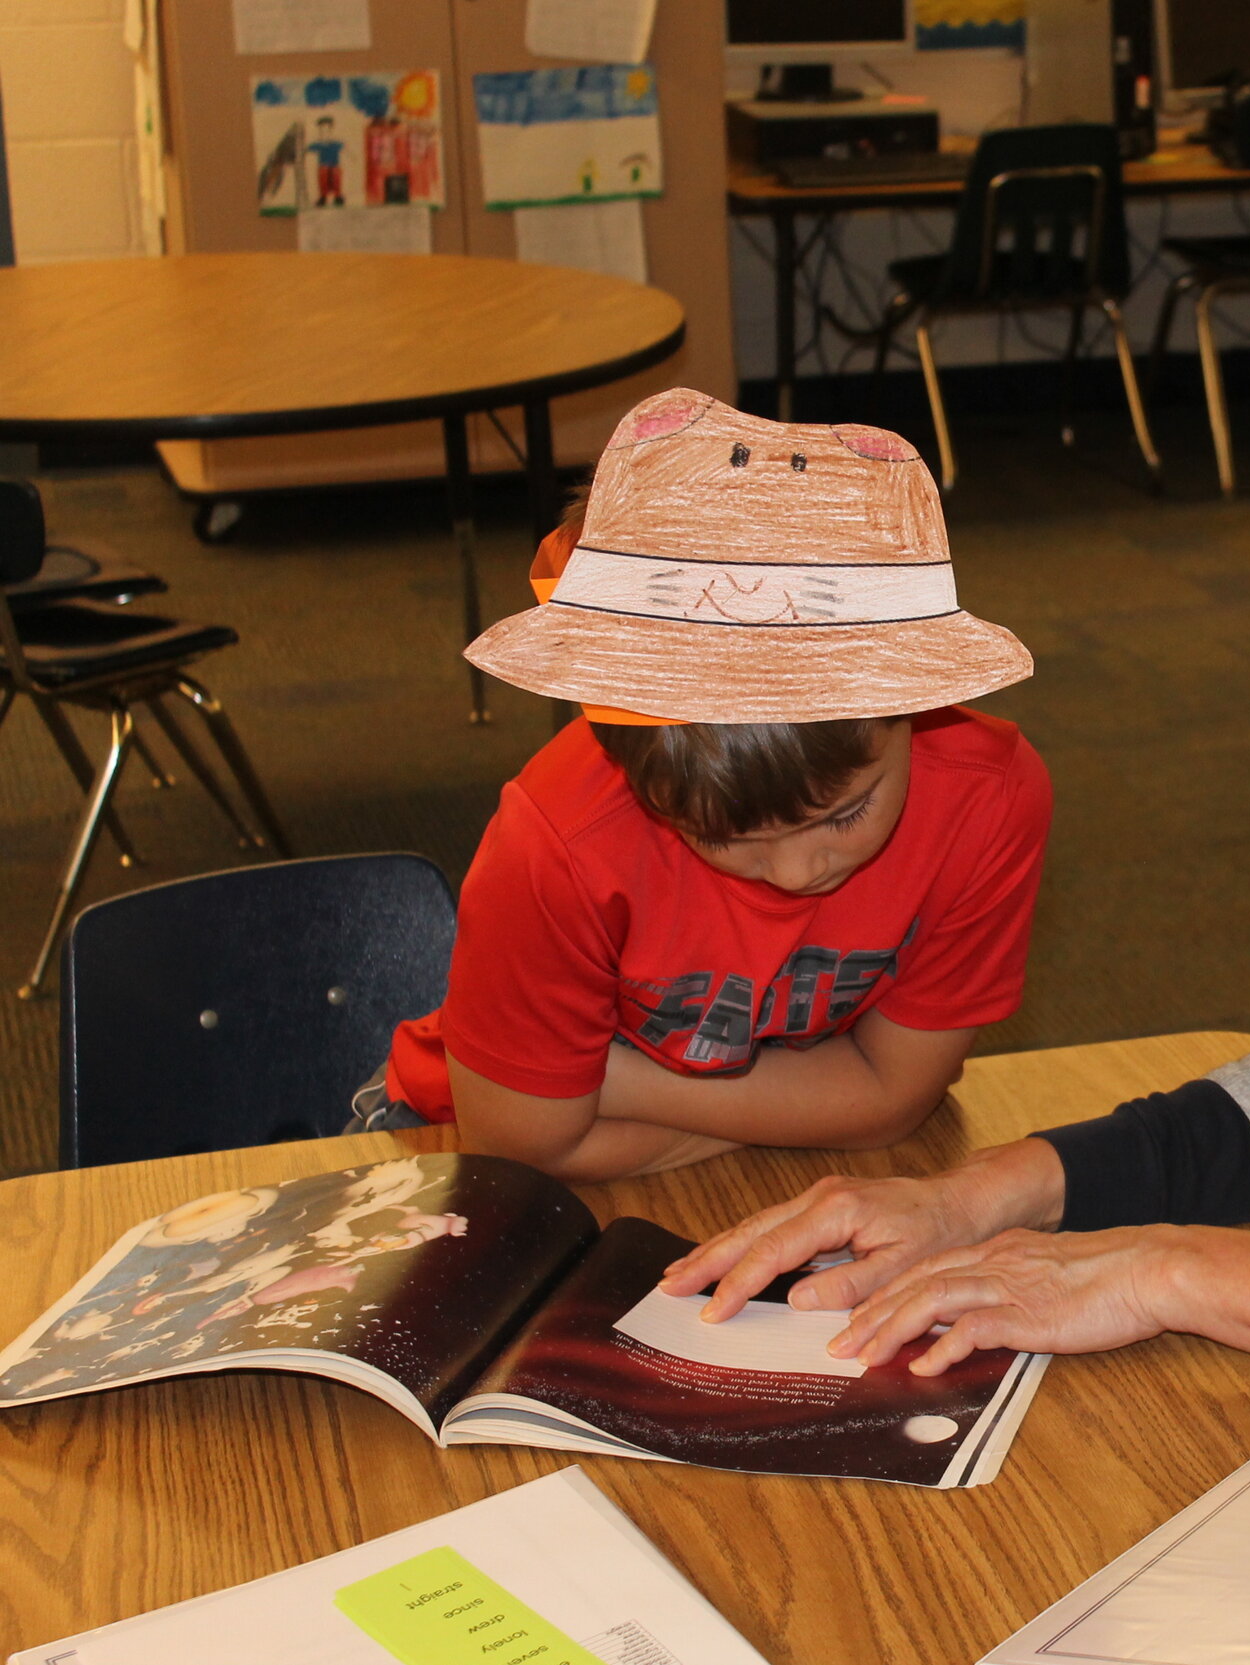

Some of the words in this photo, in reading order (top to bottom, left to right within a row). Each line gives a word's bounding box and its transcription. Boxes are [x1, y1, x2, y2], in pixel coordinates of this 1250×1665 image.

[631, 1349, 650, 1359] and
[635, 1343, 655, 1355] Way
[651, 1358, 668, 1367] one
[656, 1353, 685, 1366] Milky
[668, 1373, 689, 1381] cow
[826, 1378, 850, 1386] Then
[690, 1378, 718, 1388] milky
[694, 1387, 726, 1397] billion
[405, 1582, 463, 1610] straight
[443, 1598, 484, 1619] since
[468, 1614, 505, 1634] drew
[481, 1630, 529, 1654] lonely
